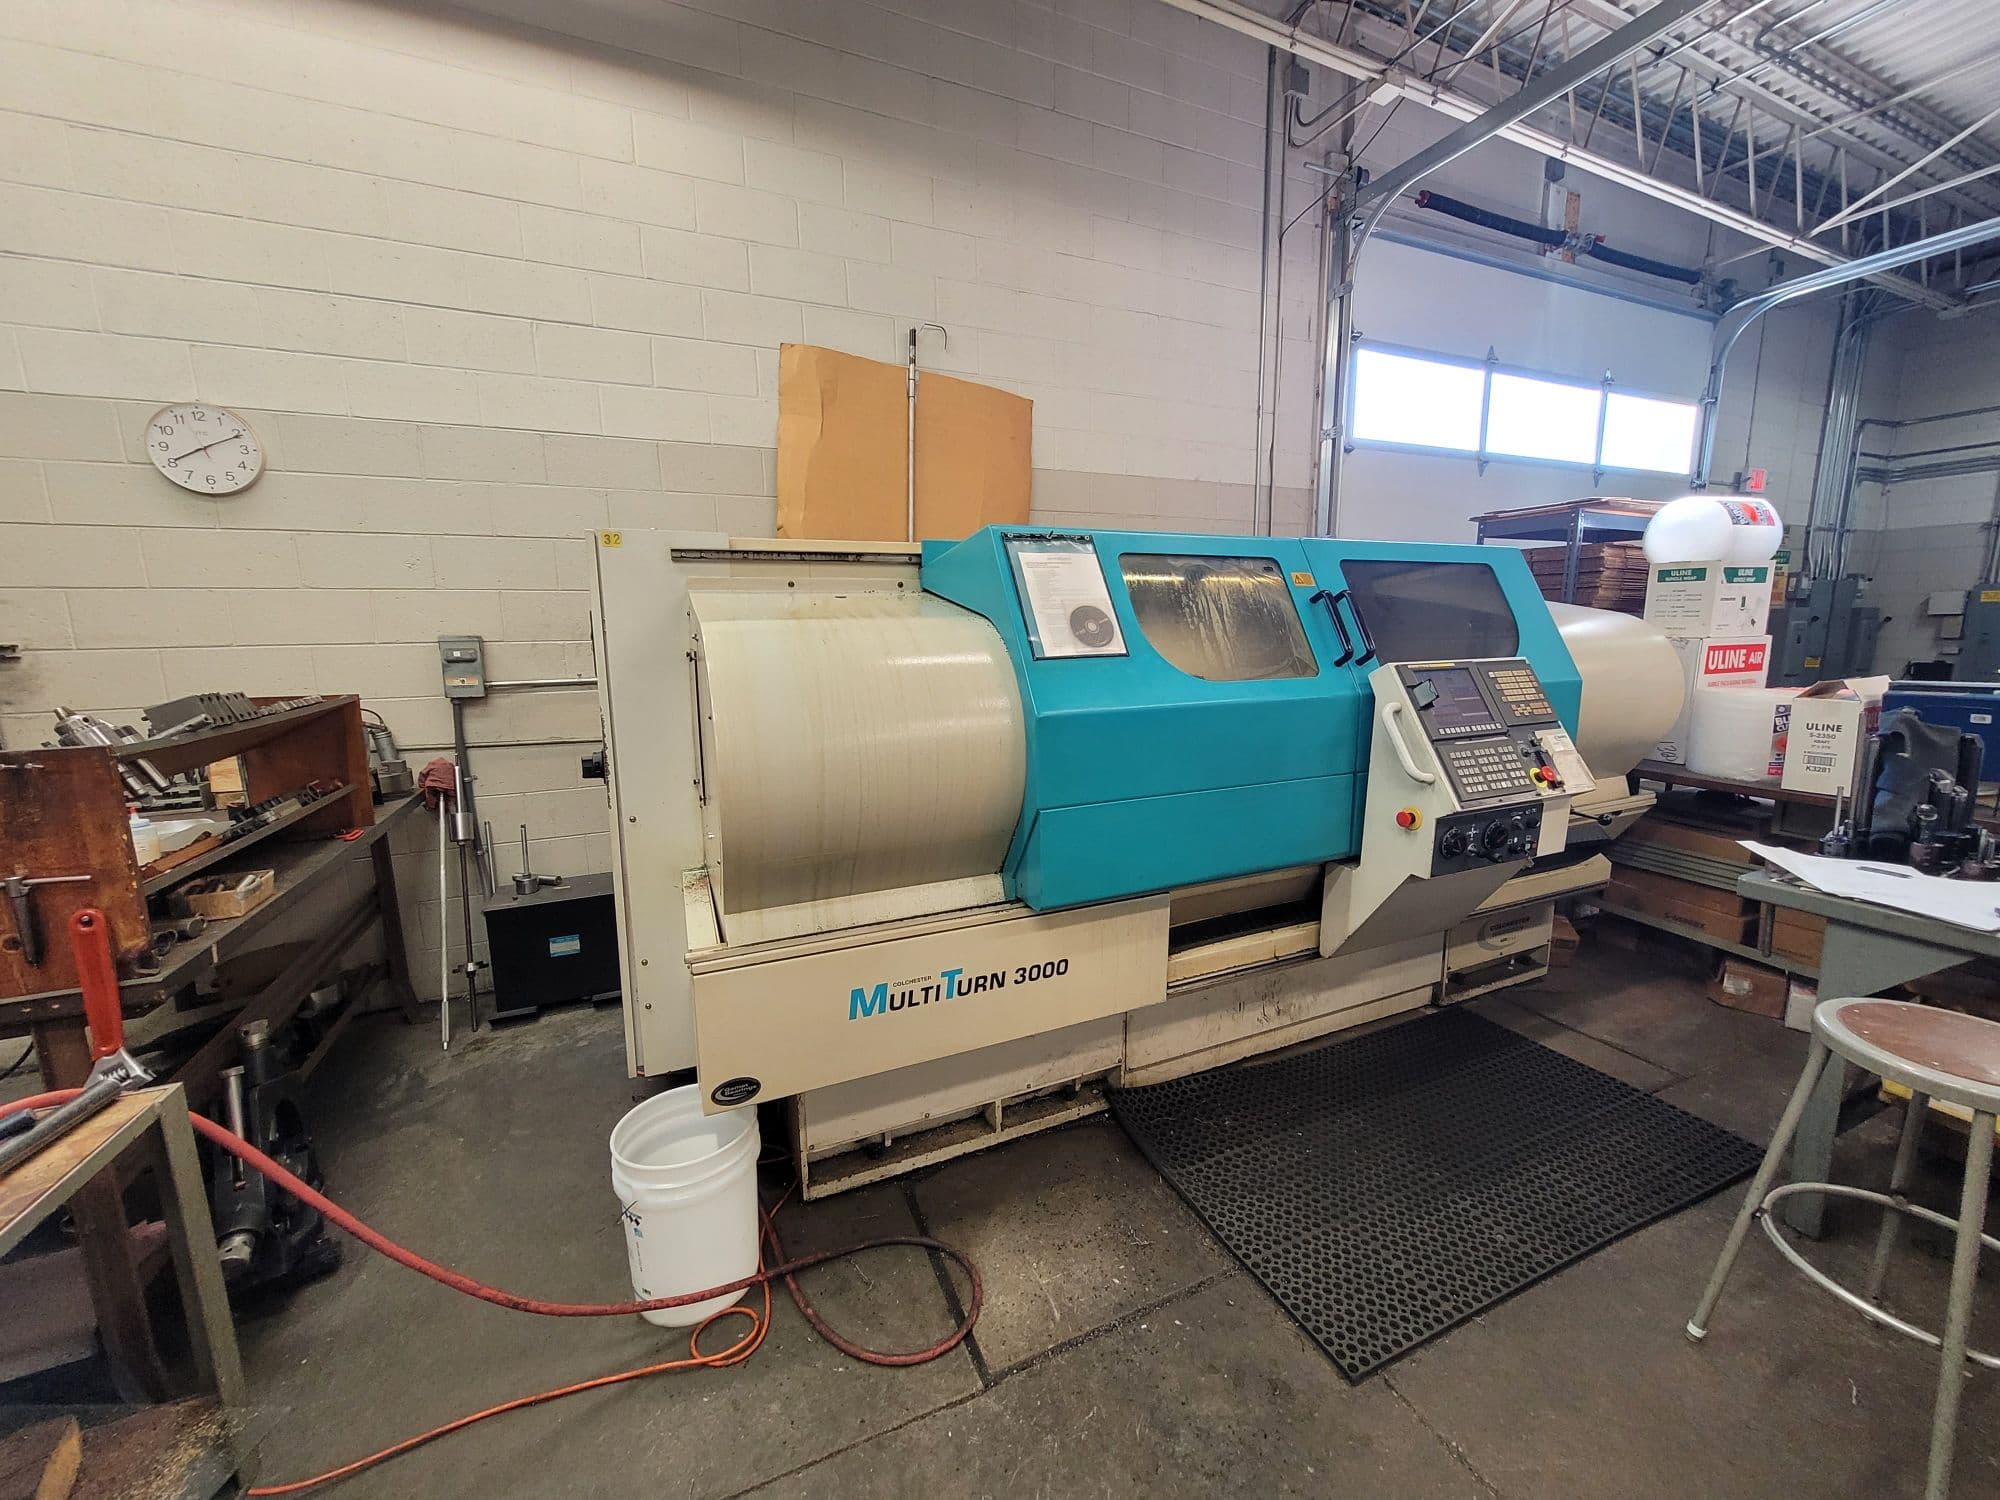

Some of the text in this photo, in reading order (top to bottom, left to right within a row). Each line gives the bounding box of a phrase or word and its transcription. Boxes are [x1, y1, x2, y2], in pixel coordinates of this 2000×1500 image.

[174, 415, 185, 425] 11
[192, 411, 205, 422] 12
[216, 417, 223, 427] 1
[159, 425, 174, 436] 10
[158, 441, 169, 452] 9
[240, 444, 250, 455] 3
[168, 457, 178, 468] 8
[238, 460, 247, 470] 4
[184, 470, 194, 480] 7
[206, 474, 216, 485] 6
[225, 471, 235, 481] 5
[603, 533, 621, 545] 32
[1671, 569, 1693, 577] ULINE
[1708, 648, 1764, 671] ULINE AIR
[1806, 722, 1843, 733] ULINE
[1013, 958, 1069, 985] 3000
[892, 975, 932, 988] COLCHESTER
